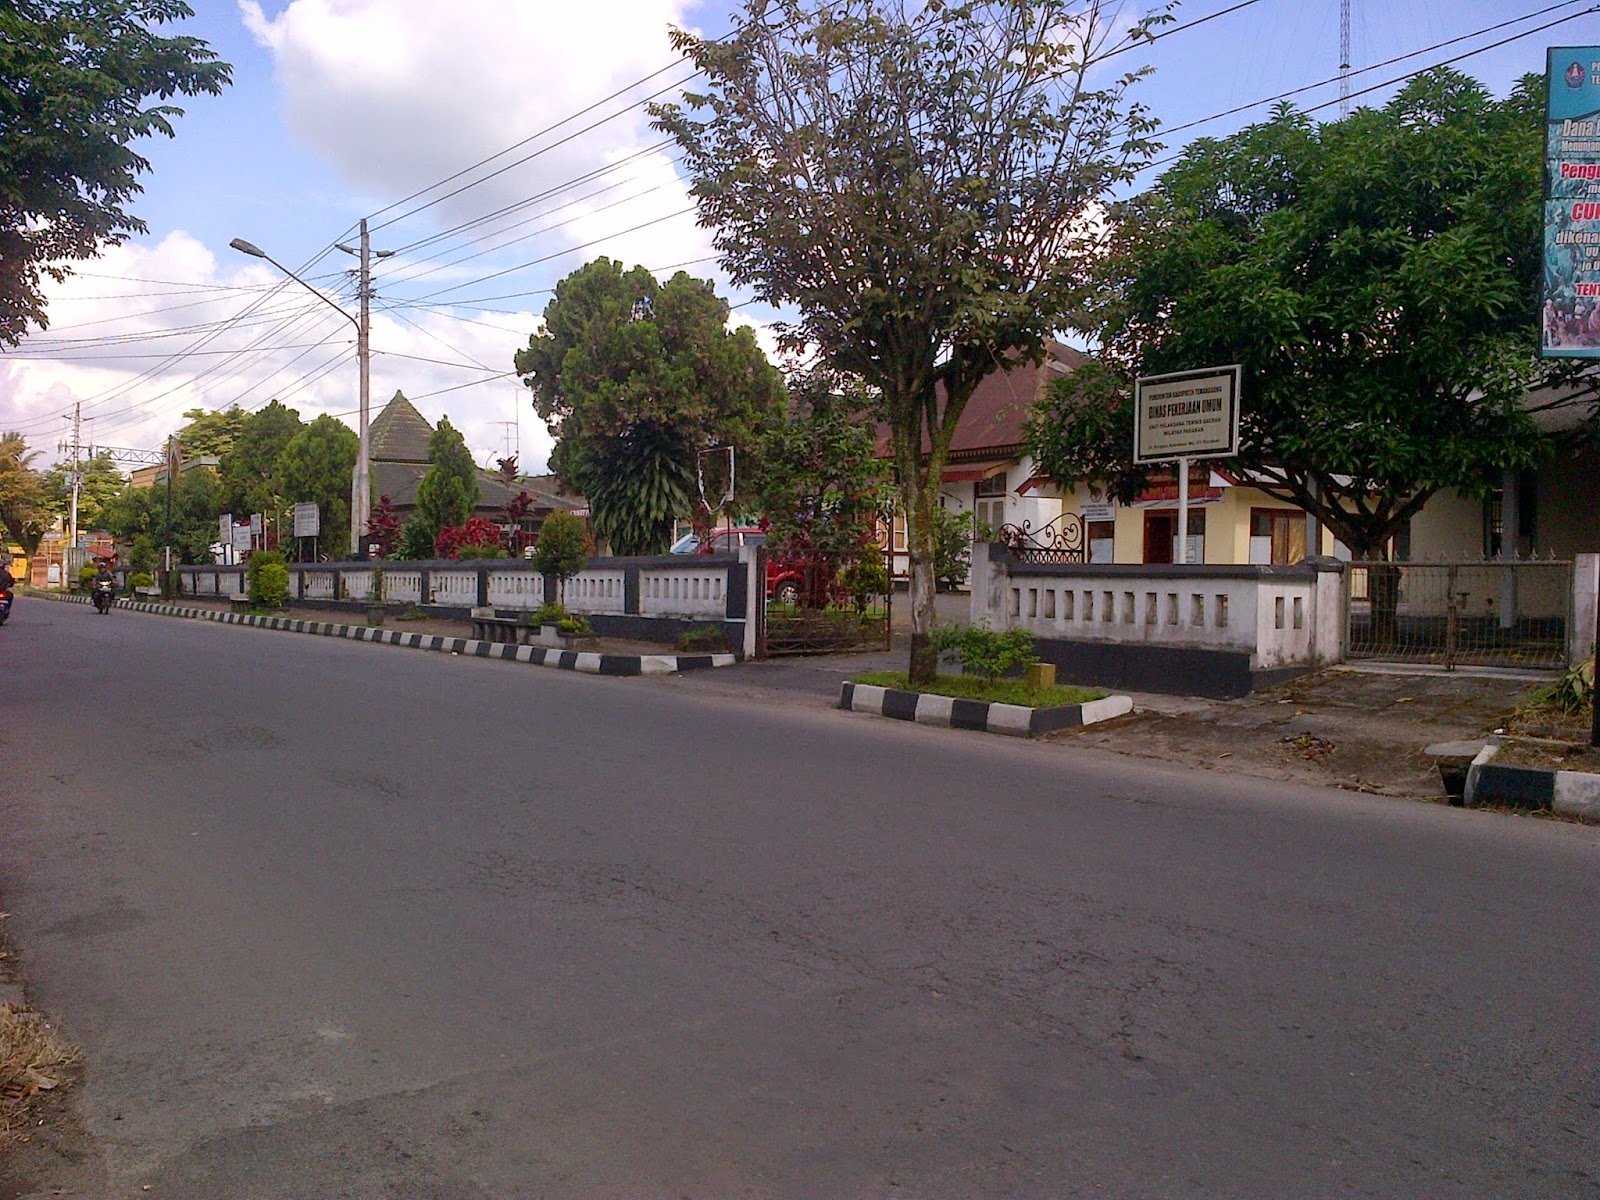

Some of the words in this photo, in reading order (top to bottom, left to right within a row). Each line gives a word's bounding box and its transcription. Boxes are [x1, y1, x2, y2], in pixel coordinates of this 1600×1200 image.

[1563, 119, 1594, 137] Dana
[1556, 229, 1600, 244] dikena
[1149, 405, 1167, 419] DINAS
[1168, 401, 1201, 417] PEKERJAAN
[1202, 398, 1222, 413] UMUM
